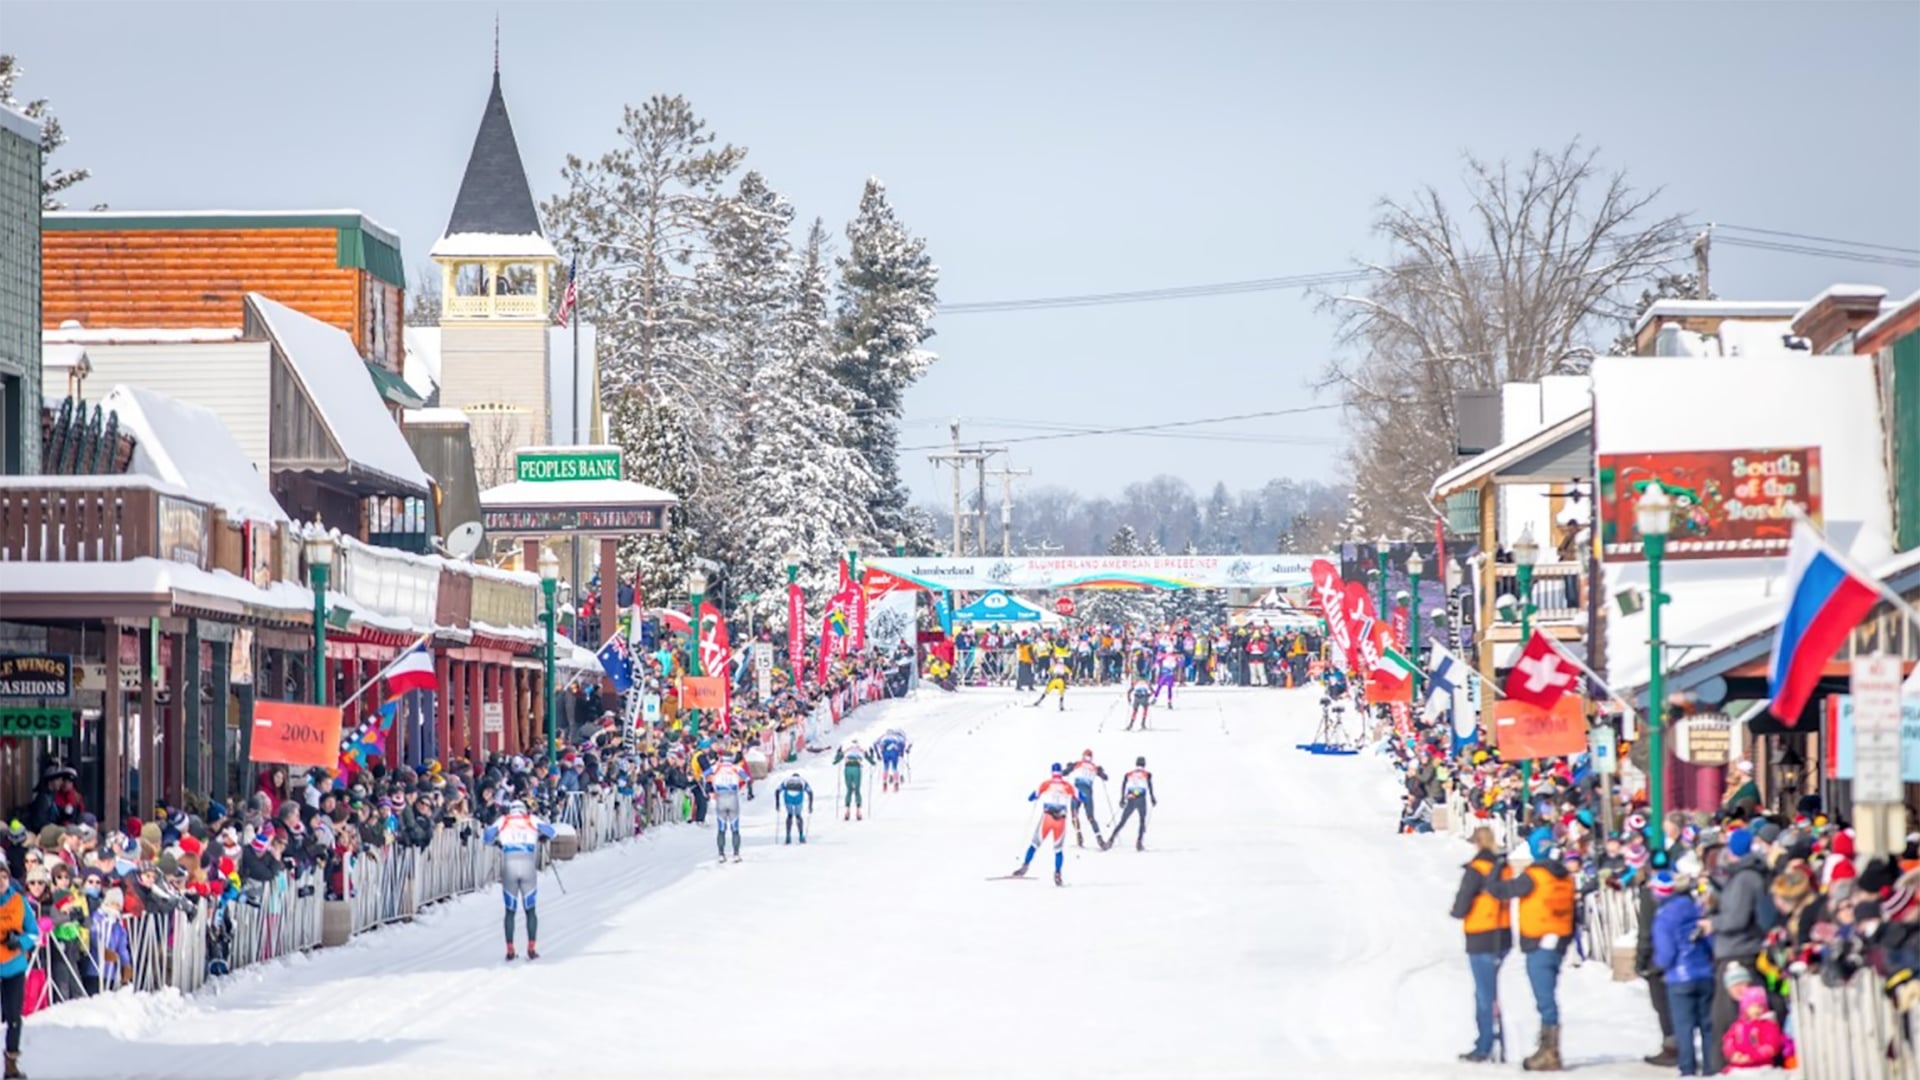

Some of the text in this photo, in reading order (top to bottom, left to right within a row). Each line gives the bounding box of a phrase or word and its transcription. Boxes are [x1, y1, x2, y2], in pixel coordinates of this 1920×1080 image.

[520, 459, 616, 478] PEOPLES BANK
[1732, 454, 1800, 477] South
[1735, 477, 1797, 498] of the
[911, 565, 974, 575] slumberland
[1028, 560, 1099, 570] SLUMBERLAND
[1101, 560, 1151, 569] AMERICAN
[1153, 558, 1218, 569] BIRKEBEINER
[1056, 603, 1076, 611] STOP
[16, 657, 65, 677] WINGS
[758, 656, 770, 667] 15
[281, 723, 325, 744] 200M
